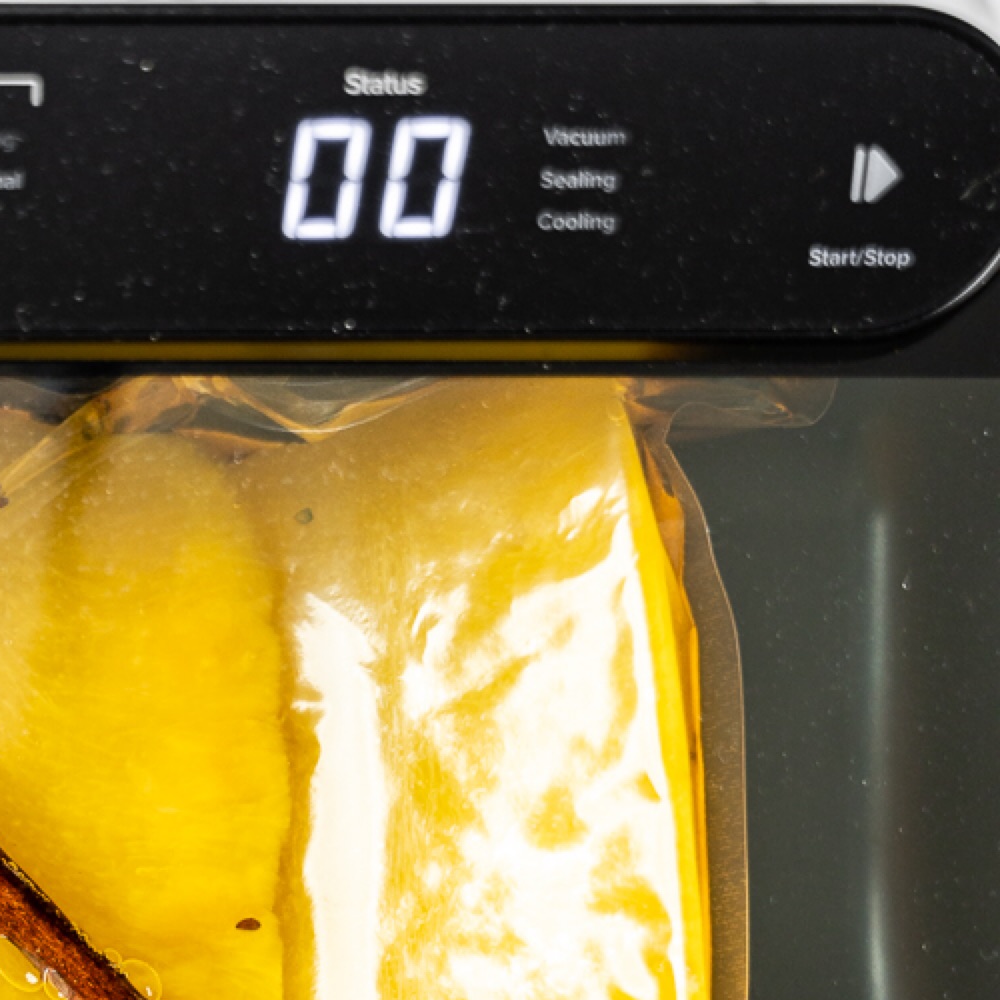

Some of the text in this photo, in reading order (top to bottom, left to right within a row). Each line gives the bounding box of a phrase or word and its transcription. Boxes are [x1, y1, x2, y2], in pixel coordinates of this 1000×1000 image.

[343, 66, 428, 96] Status
[543, 124, 629, 147] Vacuum
[281, 115, 472, 240] 00
[540, 167, 619, 192] Sealing
[537, 212, 619, 234] Cooling
[808, 244, 914, 269] Start/Stop
